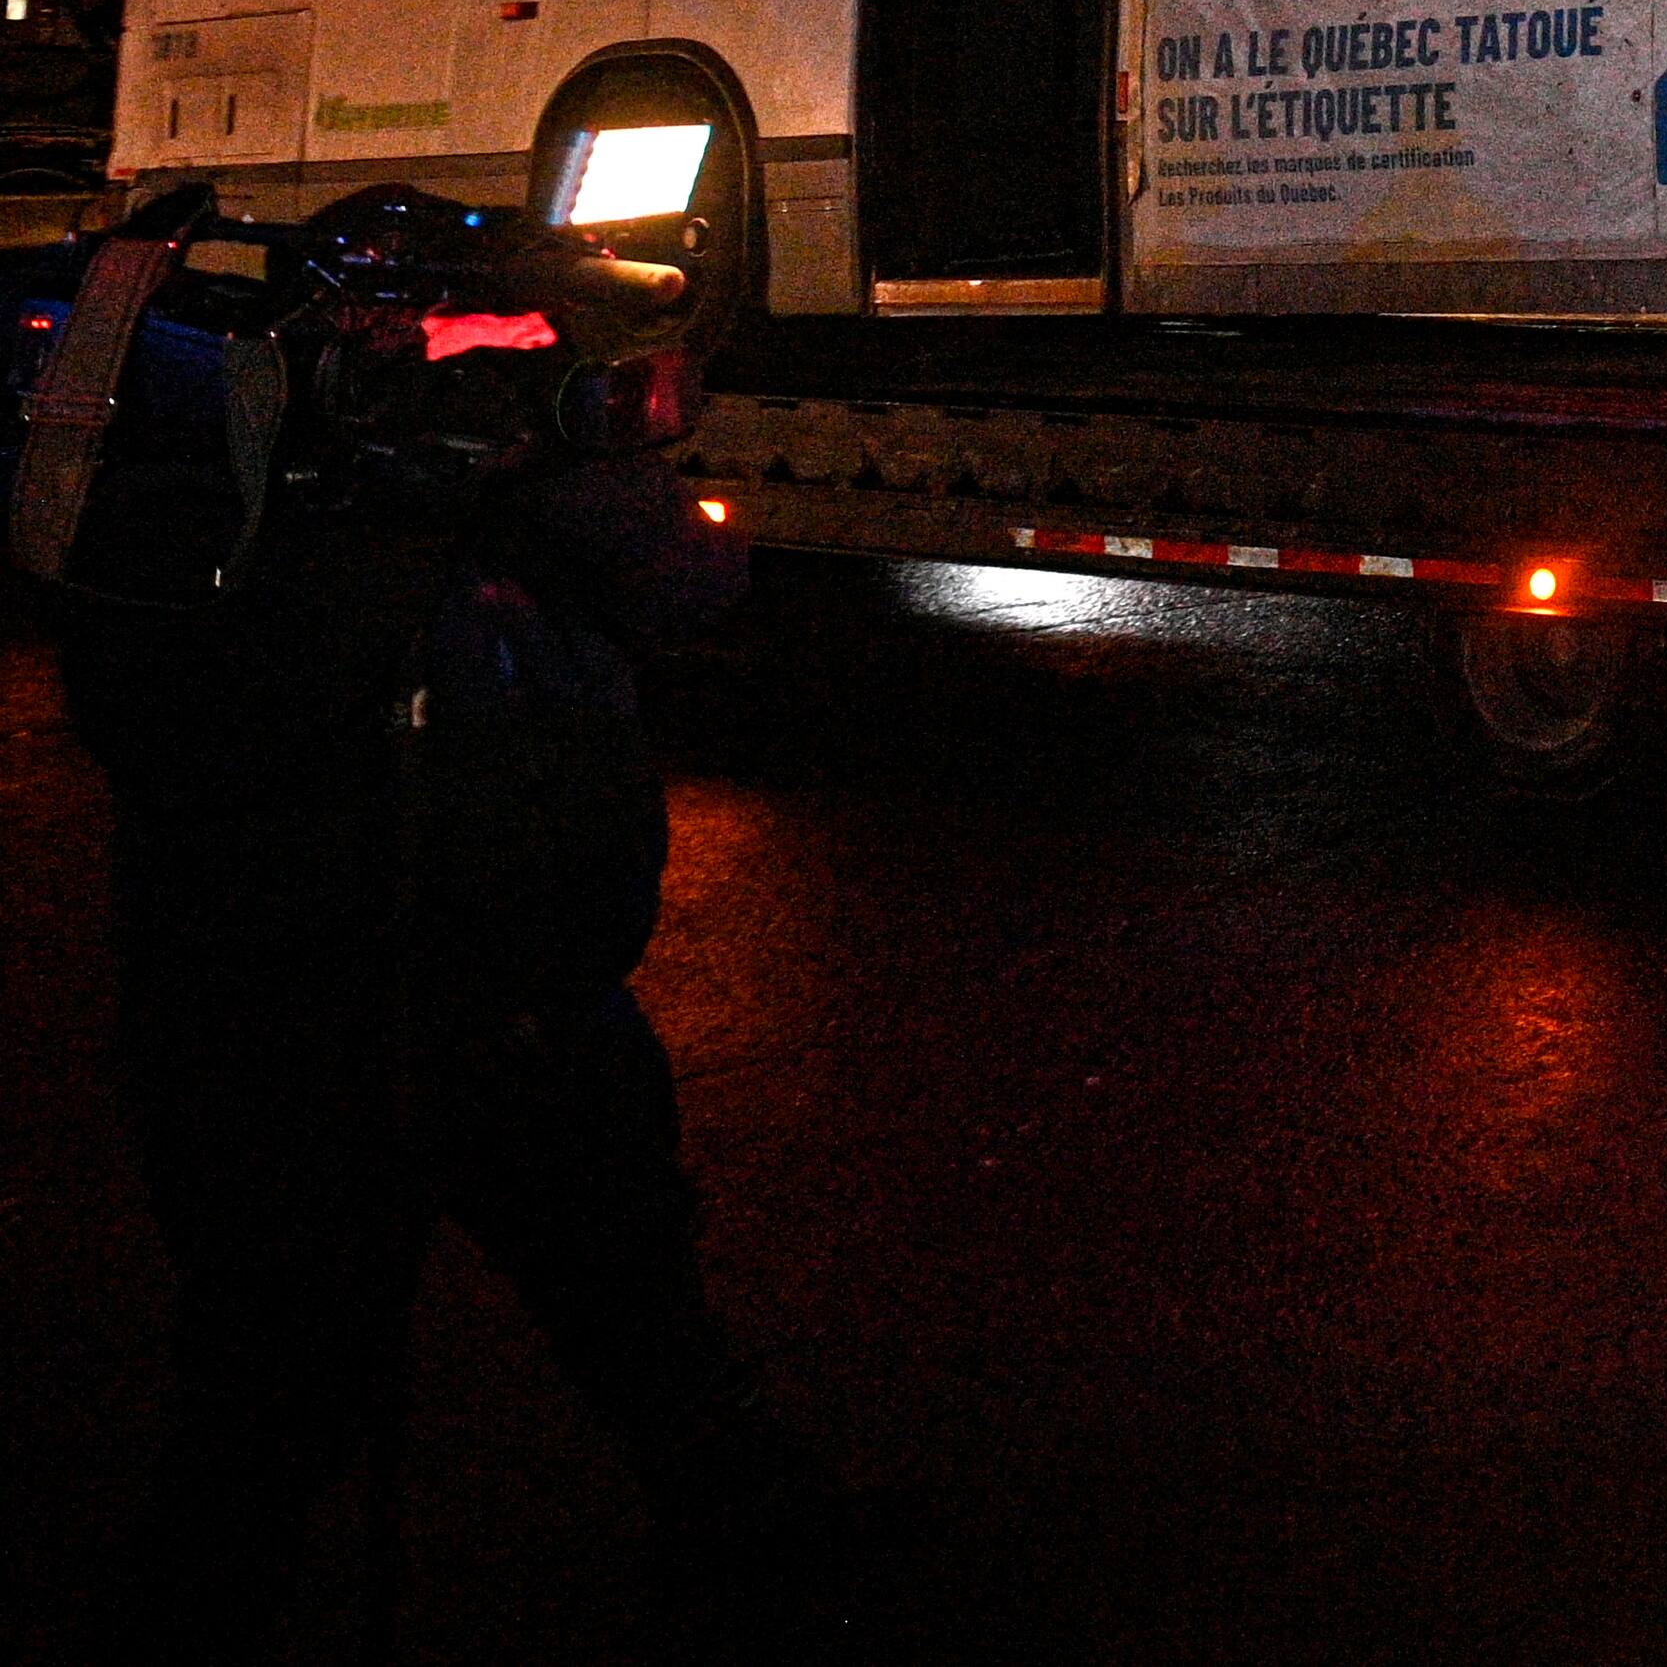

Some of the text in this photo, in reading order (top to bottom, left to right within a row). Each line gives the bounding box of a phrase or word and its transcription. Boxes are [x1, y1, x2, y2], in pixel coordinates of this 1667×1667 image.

[1157, 36, 1201, 82] ON
[1212, 32, 1235, 80] A
[1248, 28, 1290, 78] LE
[1300, 12, 1441, 79] QUÉBEC
[1156, 81, 1457, 144] SUR L'ÉTIQUETTE
[1157, 146, 1475, 178] Recherchez les marques de certification
[1157, 188, 1185, 208] Les
[1187, 185, 1252, 207] Produits
[1256, 185, 1277, 204] du
